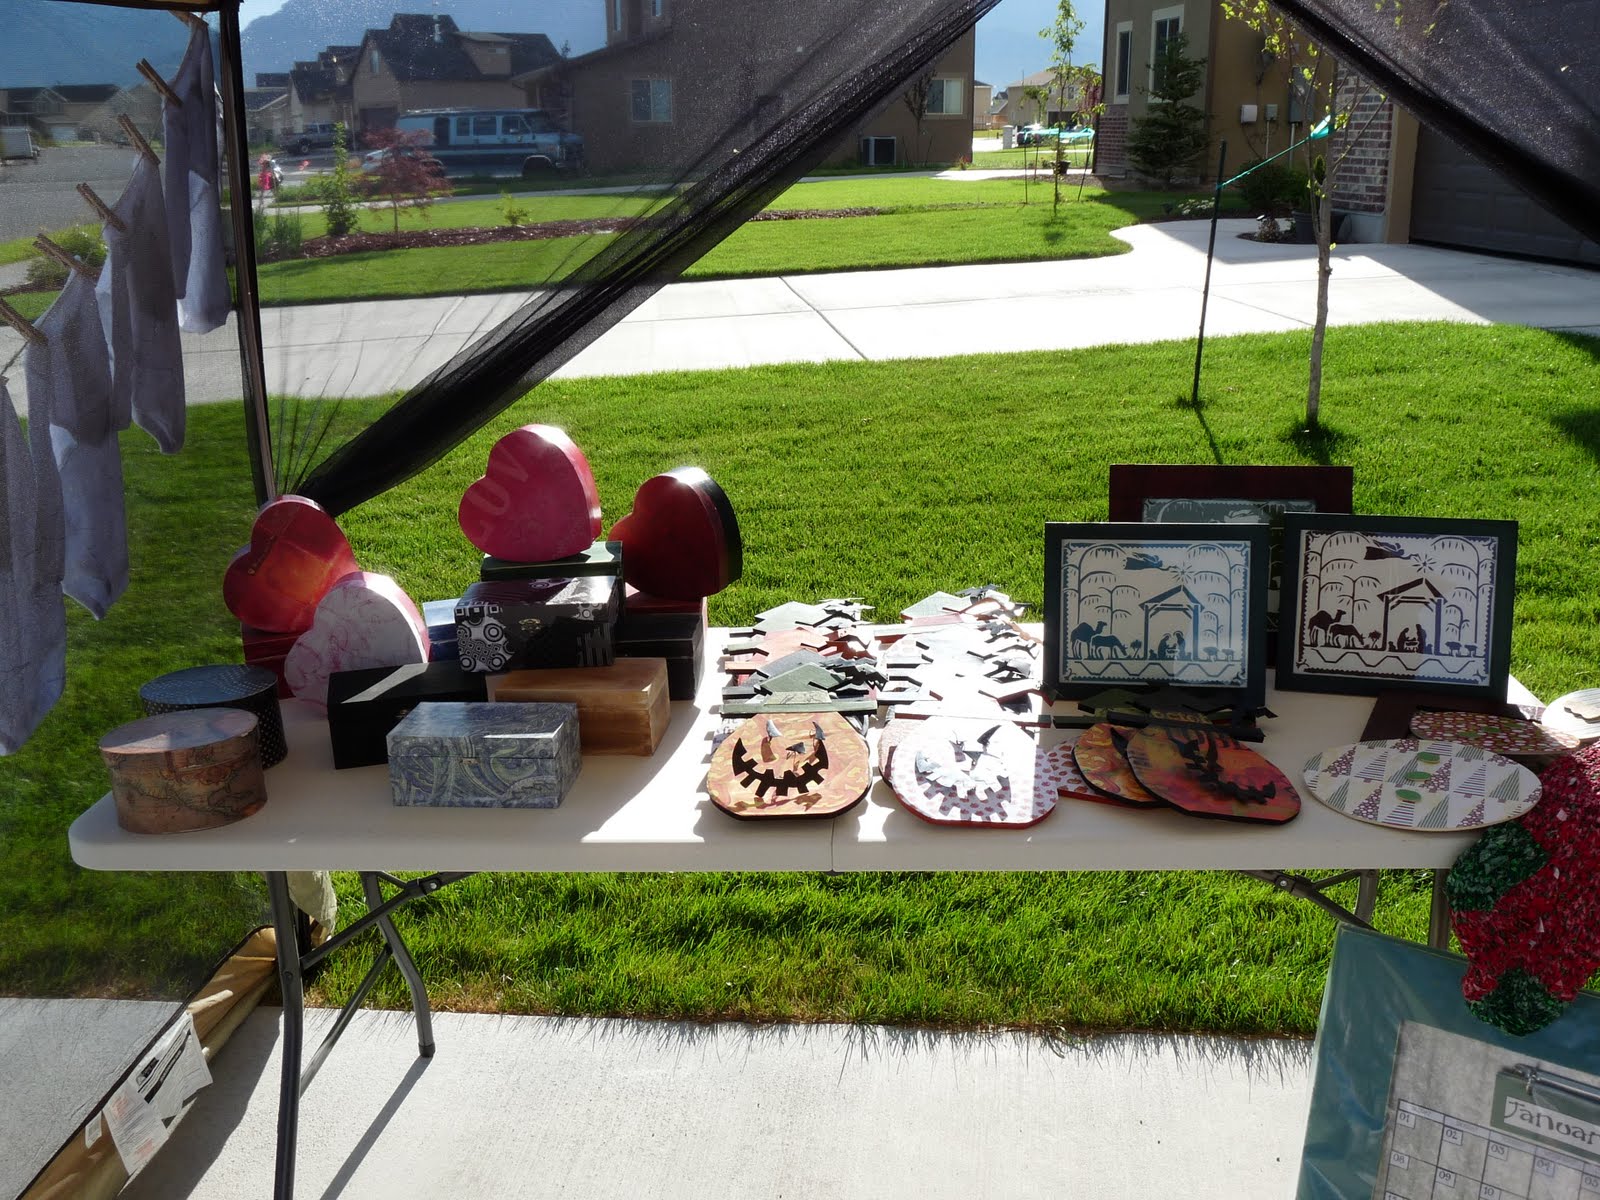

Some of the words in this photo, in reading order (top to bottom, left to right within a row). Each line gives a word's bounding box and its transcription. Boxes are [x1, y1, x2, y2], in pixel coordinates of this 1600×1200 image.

[1399, 1112, 1411, 1123] 01
[1445, 1129, 1458, 1140] 02
[1490, 1144, 1505, 1155] 03
[1392, 1153, 1405, 1164] 08
[1438, 1170, 1451, 1181] 09
[1484, 1186, 1495, 1196] 10
